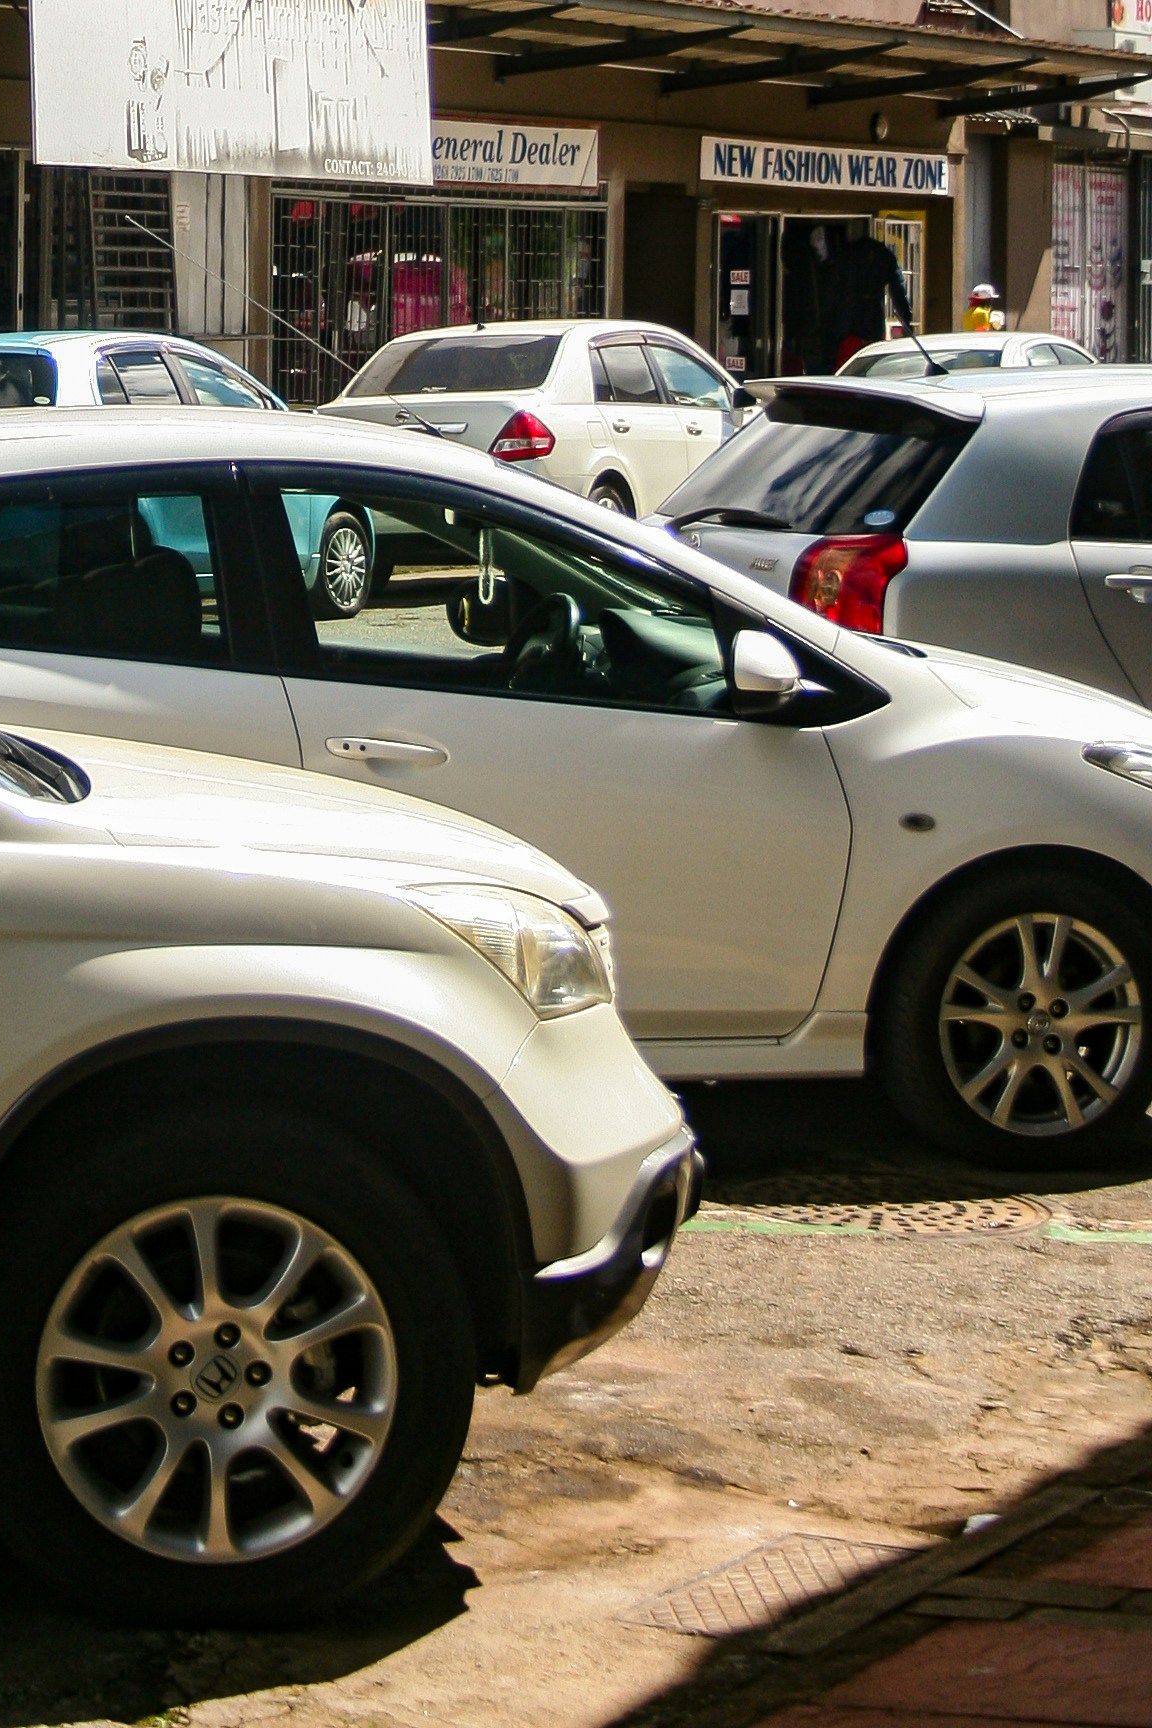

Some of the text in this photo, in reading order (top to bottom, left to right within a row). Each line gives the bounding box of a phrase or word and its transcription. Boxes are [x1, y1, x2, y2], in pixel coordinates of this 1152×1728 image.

[432, 129, 581, 166] eneral Dealer
[324, 158, 374, 176] CONTACT:
[713, 143, 947, 190] NEW FASHION WEAR ZONE
[731, 272, 749, 283] SALE
[726, 358, 744, 369] SALE
